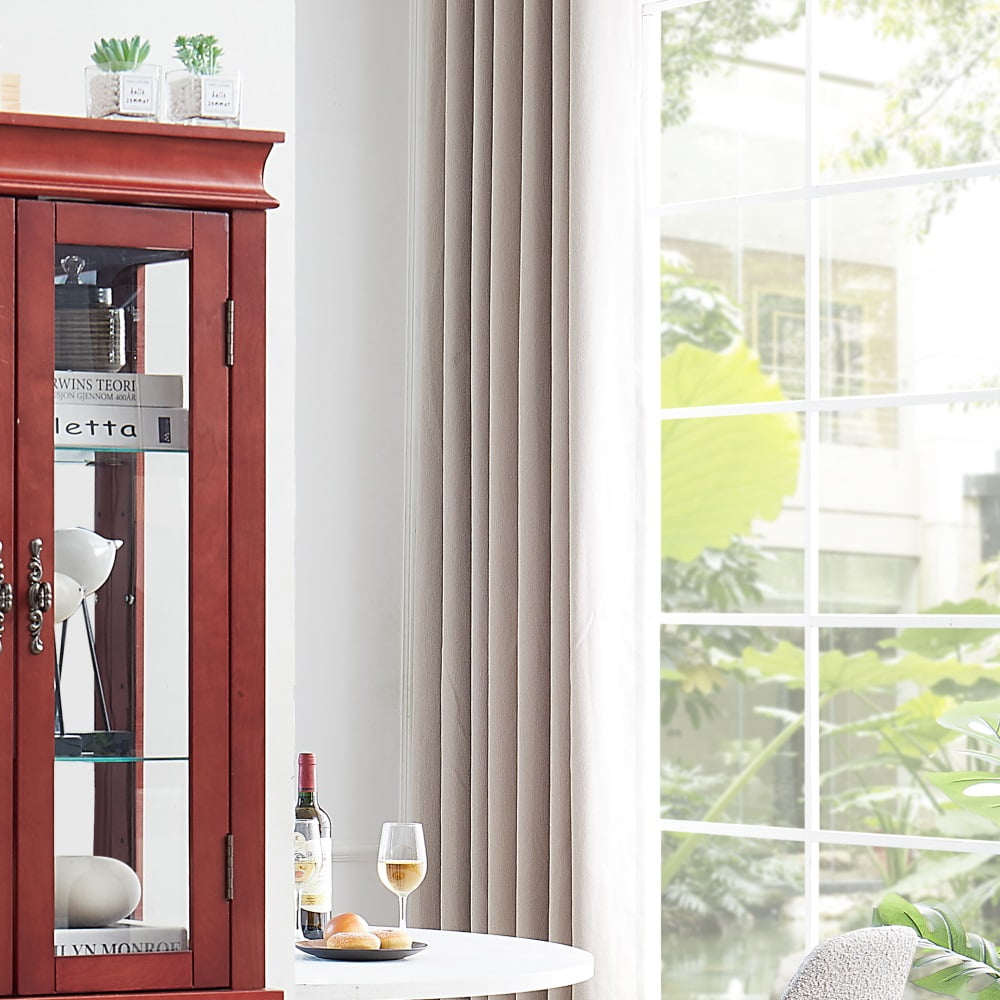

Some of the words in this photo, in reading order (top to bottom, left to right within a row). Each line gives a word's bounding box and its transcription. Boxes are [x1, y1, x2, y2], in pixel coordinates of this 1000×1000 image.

[96, 378, 136, 392] TEORI
[76, 391, 114, 402] GJENNOM
[55, 417, 137, 438] letta
[101, 942, 181, 955] MONROE
